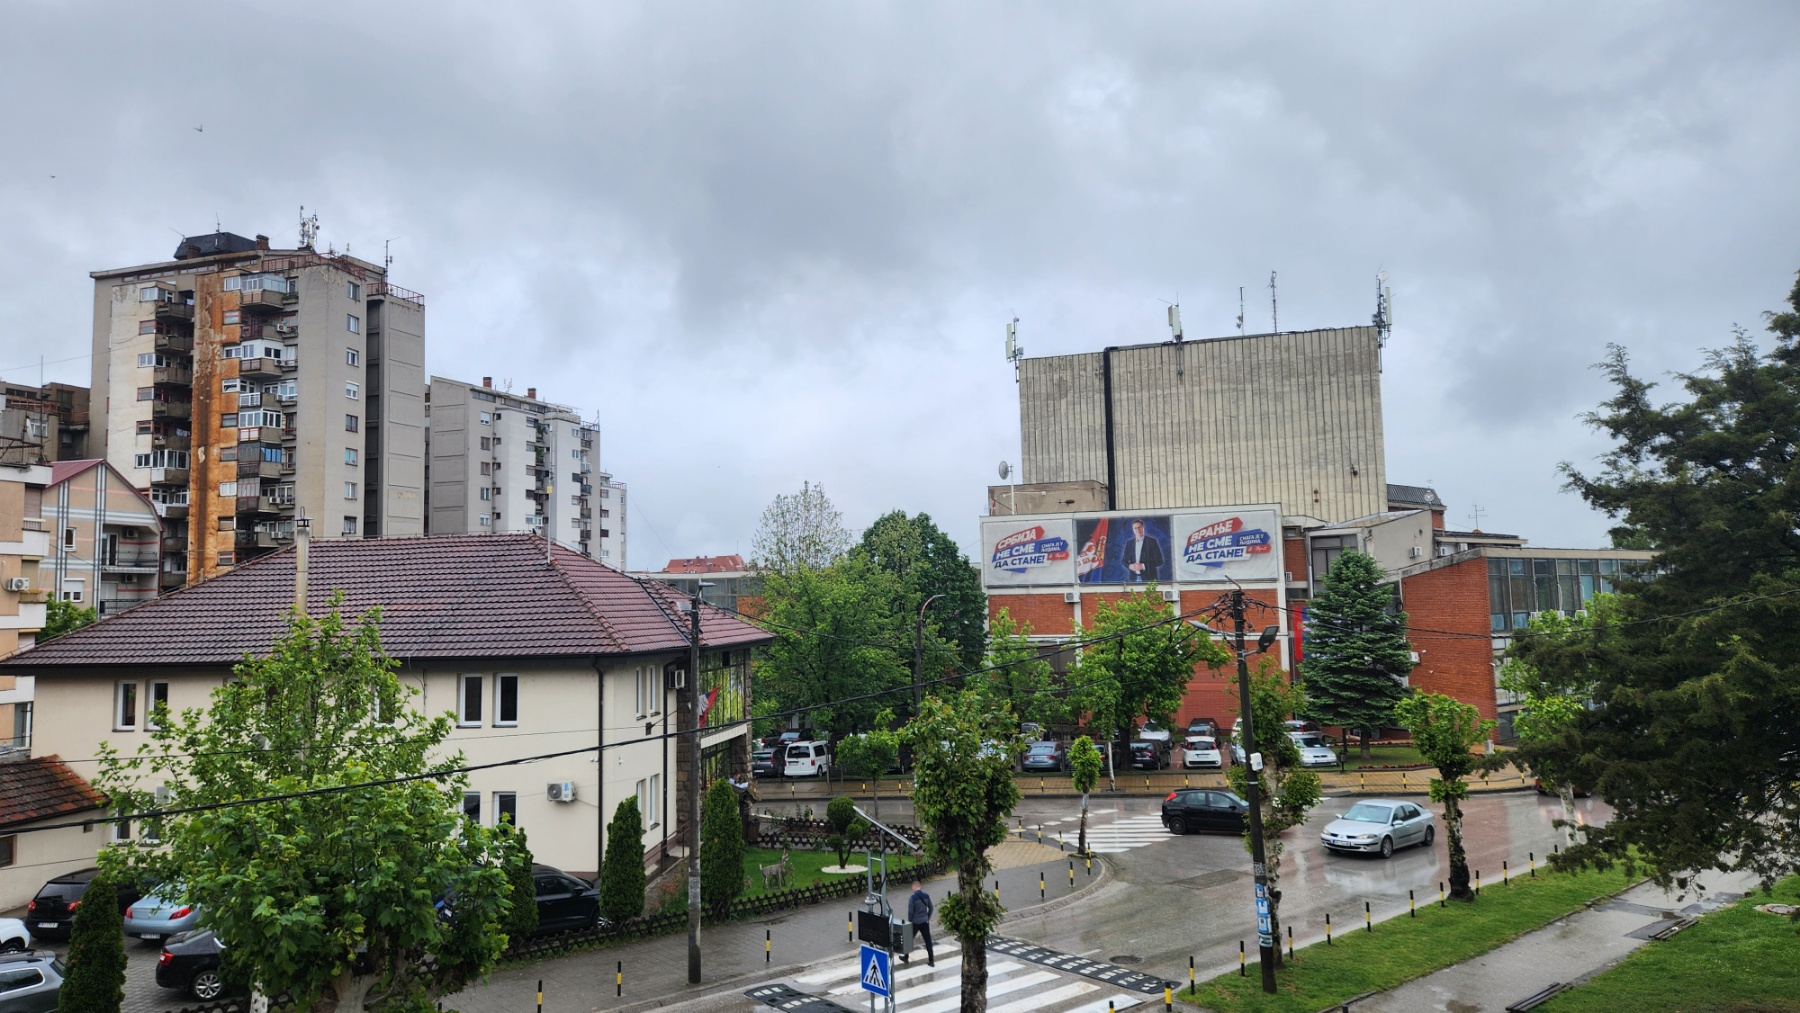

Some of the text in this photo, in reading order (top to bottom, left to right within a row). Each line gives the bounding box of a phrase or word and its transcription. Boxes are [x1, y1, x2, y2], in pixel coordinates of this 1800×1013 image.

[998, 529, 1037, 549] СРБИЈА
[1190, 520, 1234, 542] ВРАЊЕ
[996, 543, 1036, 560] НЕ СМЕ
[1188, 535, 1233, 553] НЕ СМЕ
[994, 561, 1009, 569] ДА
[1011, 555, 1045, 566] СТАНЕ!
[1186, 554, 1203, 563] ДА
[1205, 547, 1245, 560] СТАНЕ!
